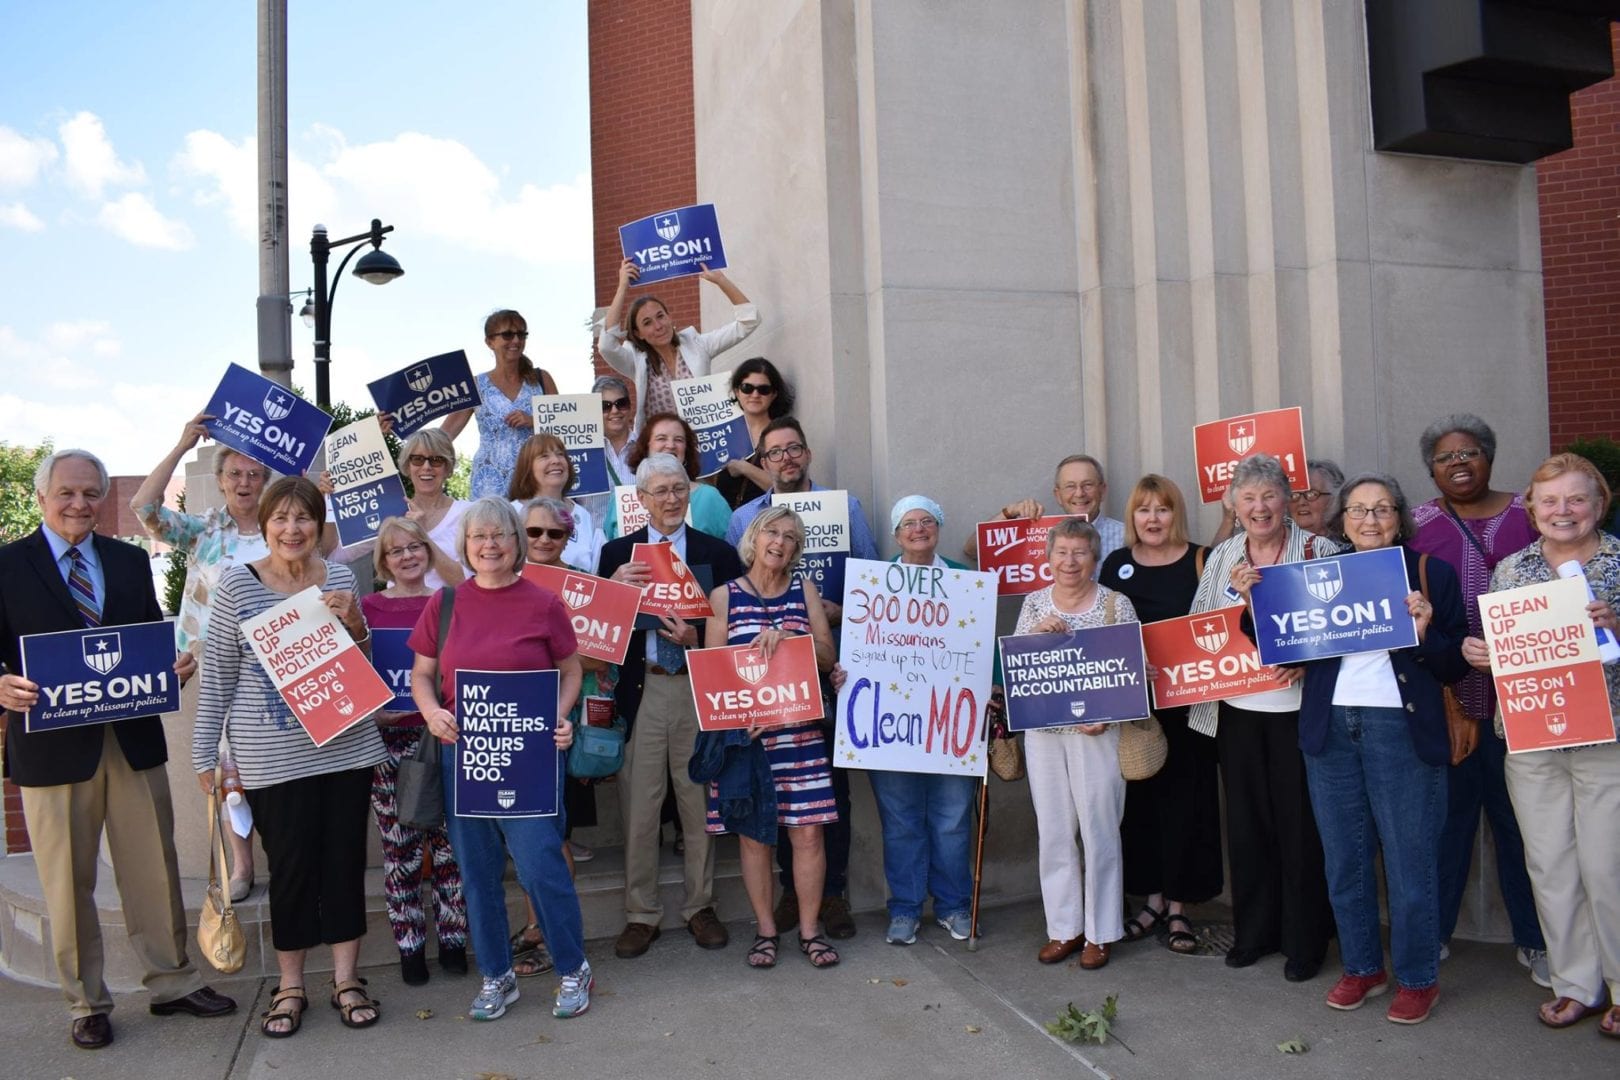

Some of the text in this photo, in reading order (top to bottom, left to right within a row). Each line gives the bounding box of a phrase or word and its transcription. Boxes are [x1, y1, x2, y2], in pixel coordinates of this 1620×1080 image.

[635, 237, 712, 264] YES ON 1
[646, 264, 660, 272] clean
[662, 262, 670, 270] up
[670, 256, 694, 266] Missouri
[694, 254, 712, 266] politics
[677, 384, 712, 396] CLEAN
[392, 380, 470, 424] YES ON 1
[424, 402, 450, 416] Missouri
[450, 396, 472, 409] politics
[538, 402, 578, 414] CLEAN
[680, 396, 694, 406] UP
[538, 414, 556, 424] UP
[686, 409, 733, 425] POLITICS
[224, 401, 306, 458] YES ON 1
[540, 424, 598, 436] MISSOURI
[564, 434, 593, 445] ITICS
[696, 425, 732, 442] ES ON 1
[223, 424, 241, 436] clean
[240, 433, 250, 442] up
[250, 437, 277, 456] Missouri
[274, 450, 296, 466] politics
[328, 432, 358, 453] CLEAN
[719, 438, 728, 446] 6
[328, 452, 340, 464] UP
[328, 450, 384, 476] MISSOURI
[582, 452, 588, 462] 1
[330, 464, 384, 486] POLITICS
[1204, 453, 1295, 484] YES 1
[335, 484, 384, 507] YES ON 1
[338, 499, 378, 520] NOV 6
[622, 504, 640, 513] UP
[804, 524, 843, 536] SOURI
[986, 526, 1018, 546] LWV
[804, 536, 838, 548] ITICS
[809, 560, 824, 568] ON
[826, 556, 832, 568] 1
[1028, 549, 1045, 559] says
[816, 570, 824, 580] 6
[886, 564, 949, 600] OVER
[988, 564, 1036, 584] YES
[642, 582, 682, 600] YES
[642, 599, 660, 608] clean
[662, 604, 672, 612] up
[674, 601, 698, 610] Missouri
[1488, 596, 1548, 620] CLEAN
[252, 608, 300, 642] CLEAN
[1270, 598, 1392, 634] YES ON 1
[571, 615, 608, 640] ON
[612, 625, 622, 643] 1
[866, 622, 946, 648] Missourians
[1274, 624, 1393, 647] To clean up Missouri politics
[1491, 618, 1516, 636] UP
[260, 636, 280, 654] UP
[268, 622, 337, 668] MISSOURI
[586, 639, 615, 653] politics
[1494, 624, 1585, 653] MISSOURI
[274, 638, 338, 681] POLITICS
[892, 655, 908, 674] up
[910, 650, 925, 666] to
[932, 649, 976, 676] VOTE
[1006, 648, 1086, 668] INTEGRITY.
[1497, 642, 1580, 670] POLITICS
[906, 672, 927, 683] on
[1008, 658, 1128, 682] TRANSPARENCY.
[1162, 651, 1260, 686] YES ON
[42, 672, 168, 707] YES ON 1
[288, 661, 345, 701] YES ON 1
[1010, 672, 1140, 698] ACCOUNTABILITY.
[1166, 689, 1174, 697] to
[1176, 686, 1196, 696] clean
[1198, 685, 1208, 696] up
[1210, 679, 1246, 690] Missouri
[1247, 672, 1274, 688] politic
[1503, 672, 1575, 696] YES ON 1
[296, 680, 344, 715] NOV 6
[463, 684, 490, 700] MY
[706, 681, 810, 710] YES ON 1
[42, 711, 52, 720] to
[53, 707, 78, 718] clean
[80, 707, 92, 718] up
[94, 700, 134, 713] Missouri
[134, 695, 168, 711] politics
[462, 702, 518, 718] VOICE
[718, 712, 737, 720] clean
[738, 712, 747, 722] up
[748, 708, 782, 718] Missouri
[784, 702, 811, 717] politics
[1506, 692, 1565, 714] NOV 6
[463, 717, 549, 732] MATTERS.
[846, 678, 977, 758] Clean MO
[462, 736, 524, 752] YOURS
[463, 751, 512, 766] DOES
[462, 766, 504, 782] TOO.
